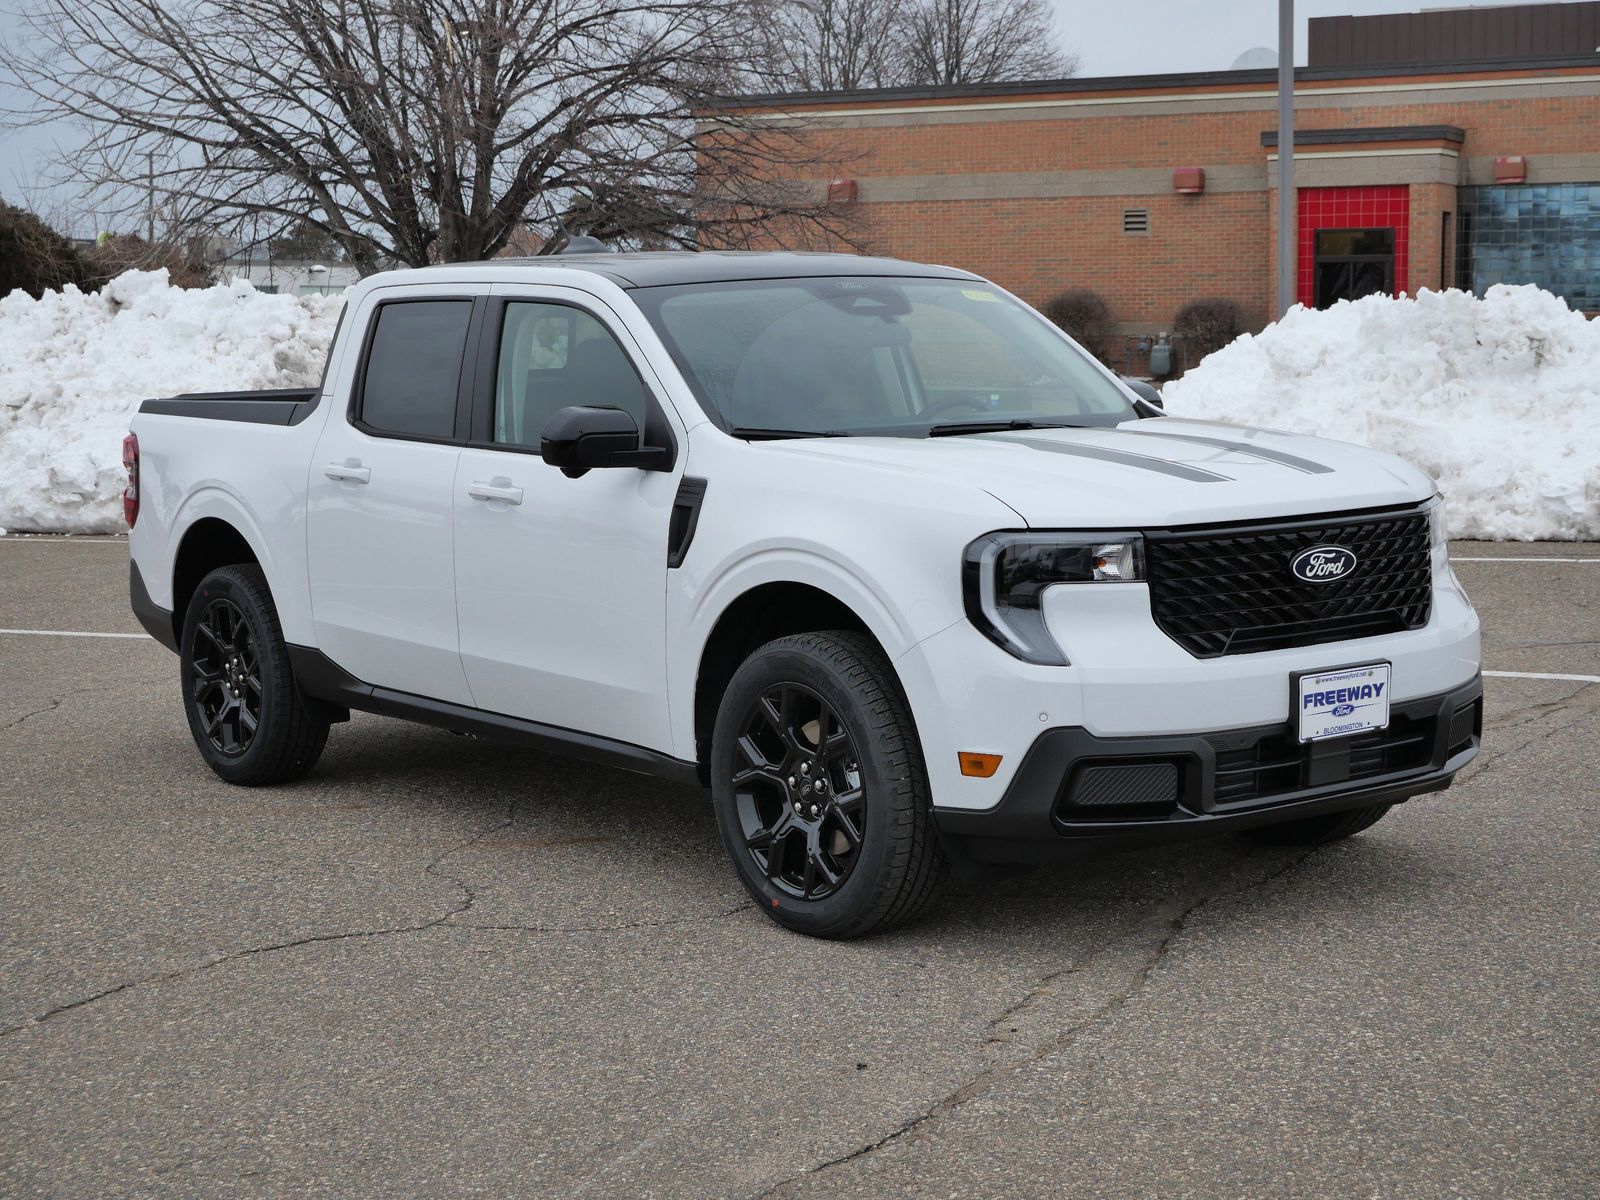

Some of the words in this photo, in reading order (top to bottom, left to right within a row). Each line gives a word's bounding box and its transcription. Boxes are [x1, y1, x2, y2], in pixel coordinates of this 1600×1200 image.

[1306, 553, 1345, 577] Ford
[1321, 671, 1367, 683] www.freewayford.net
[1303, 682, 1385, 709] FREEWAY
[1335, 704, 1352, 716] Ford
[1323, 721, 1363, 735] BLOOMINGTON
